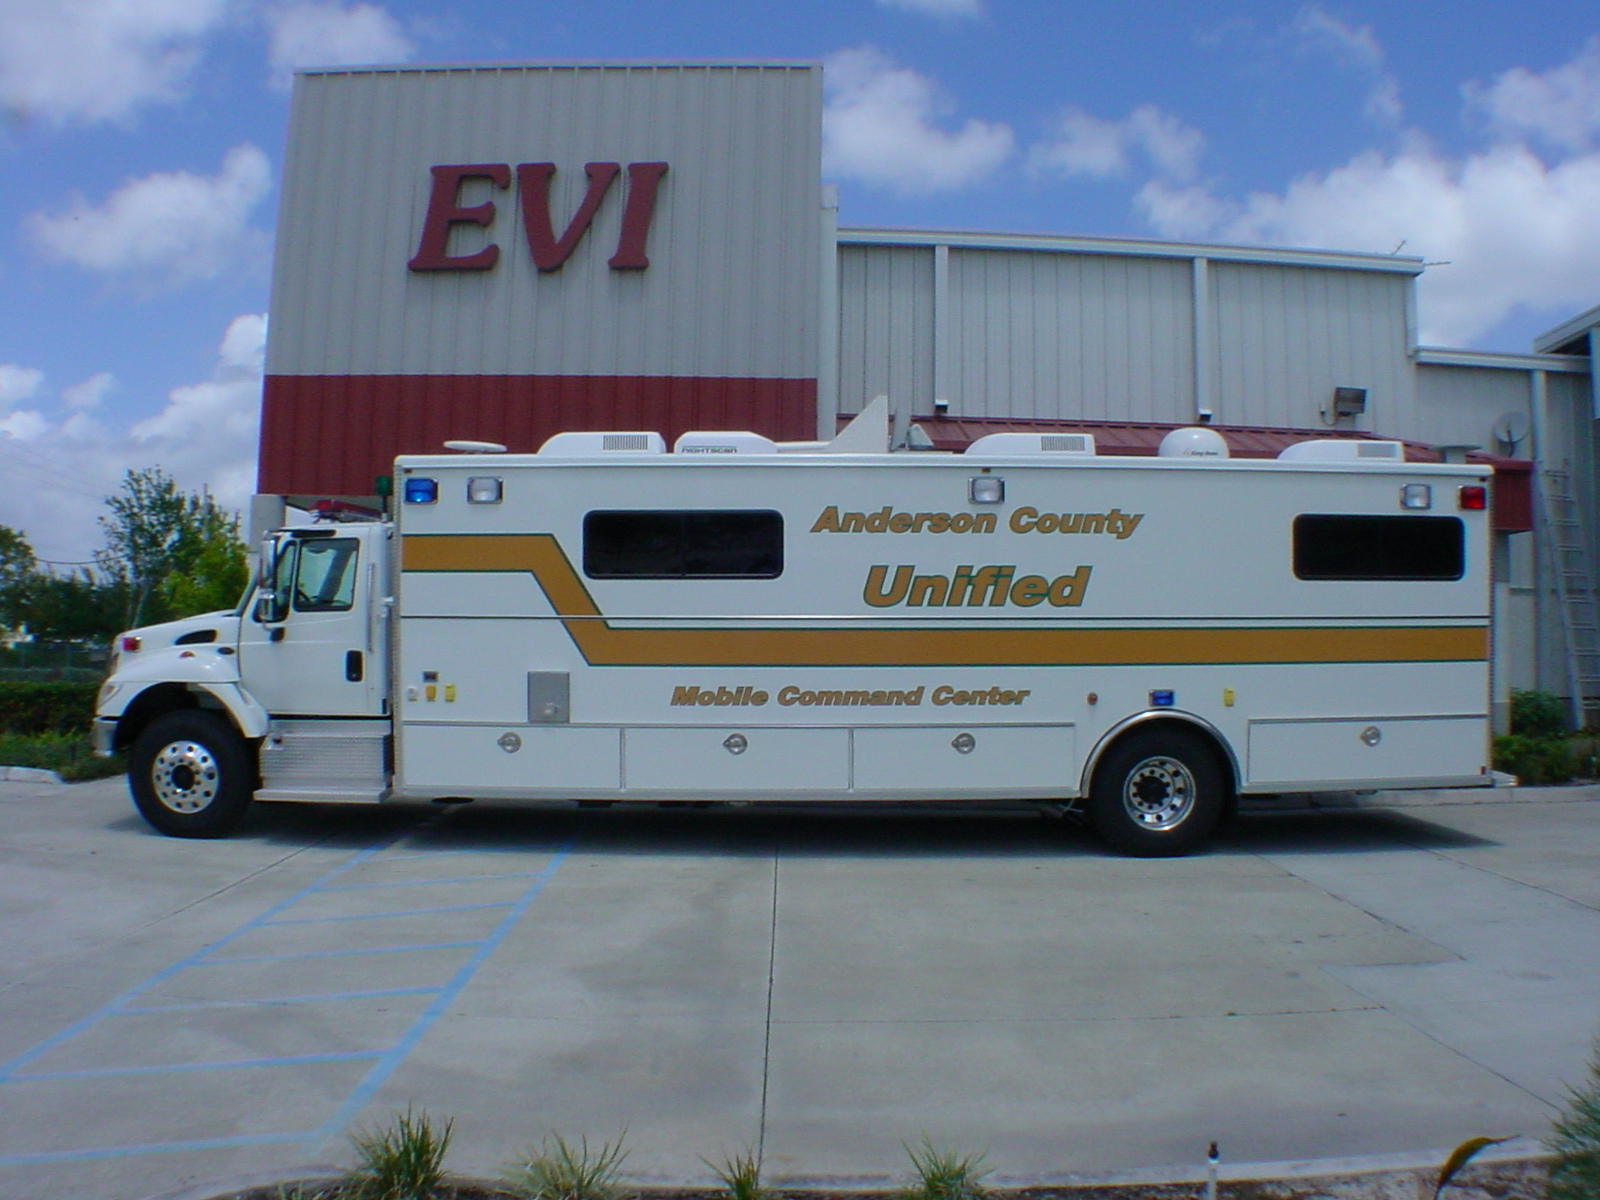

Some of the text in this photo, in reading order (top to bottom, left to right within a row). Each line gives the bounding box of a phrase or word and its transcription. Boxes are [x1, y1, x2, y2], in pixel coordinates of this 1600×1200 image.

[408, 162, 669, 273] EVI
[810, 506, 1144, 540] Anderson County
[863, 565, 1094, 608] Unified
[670, 685, 1032, 707] Mobile Command Center
